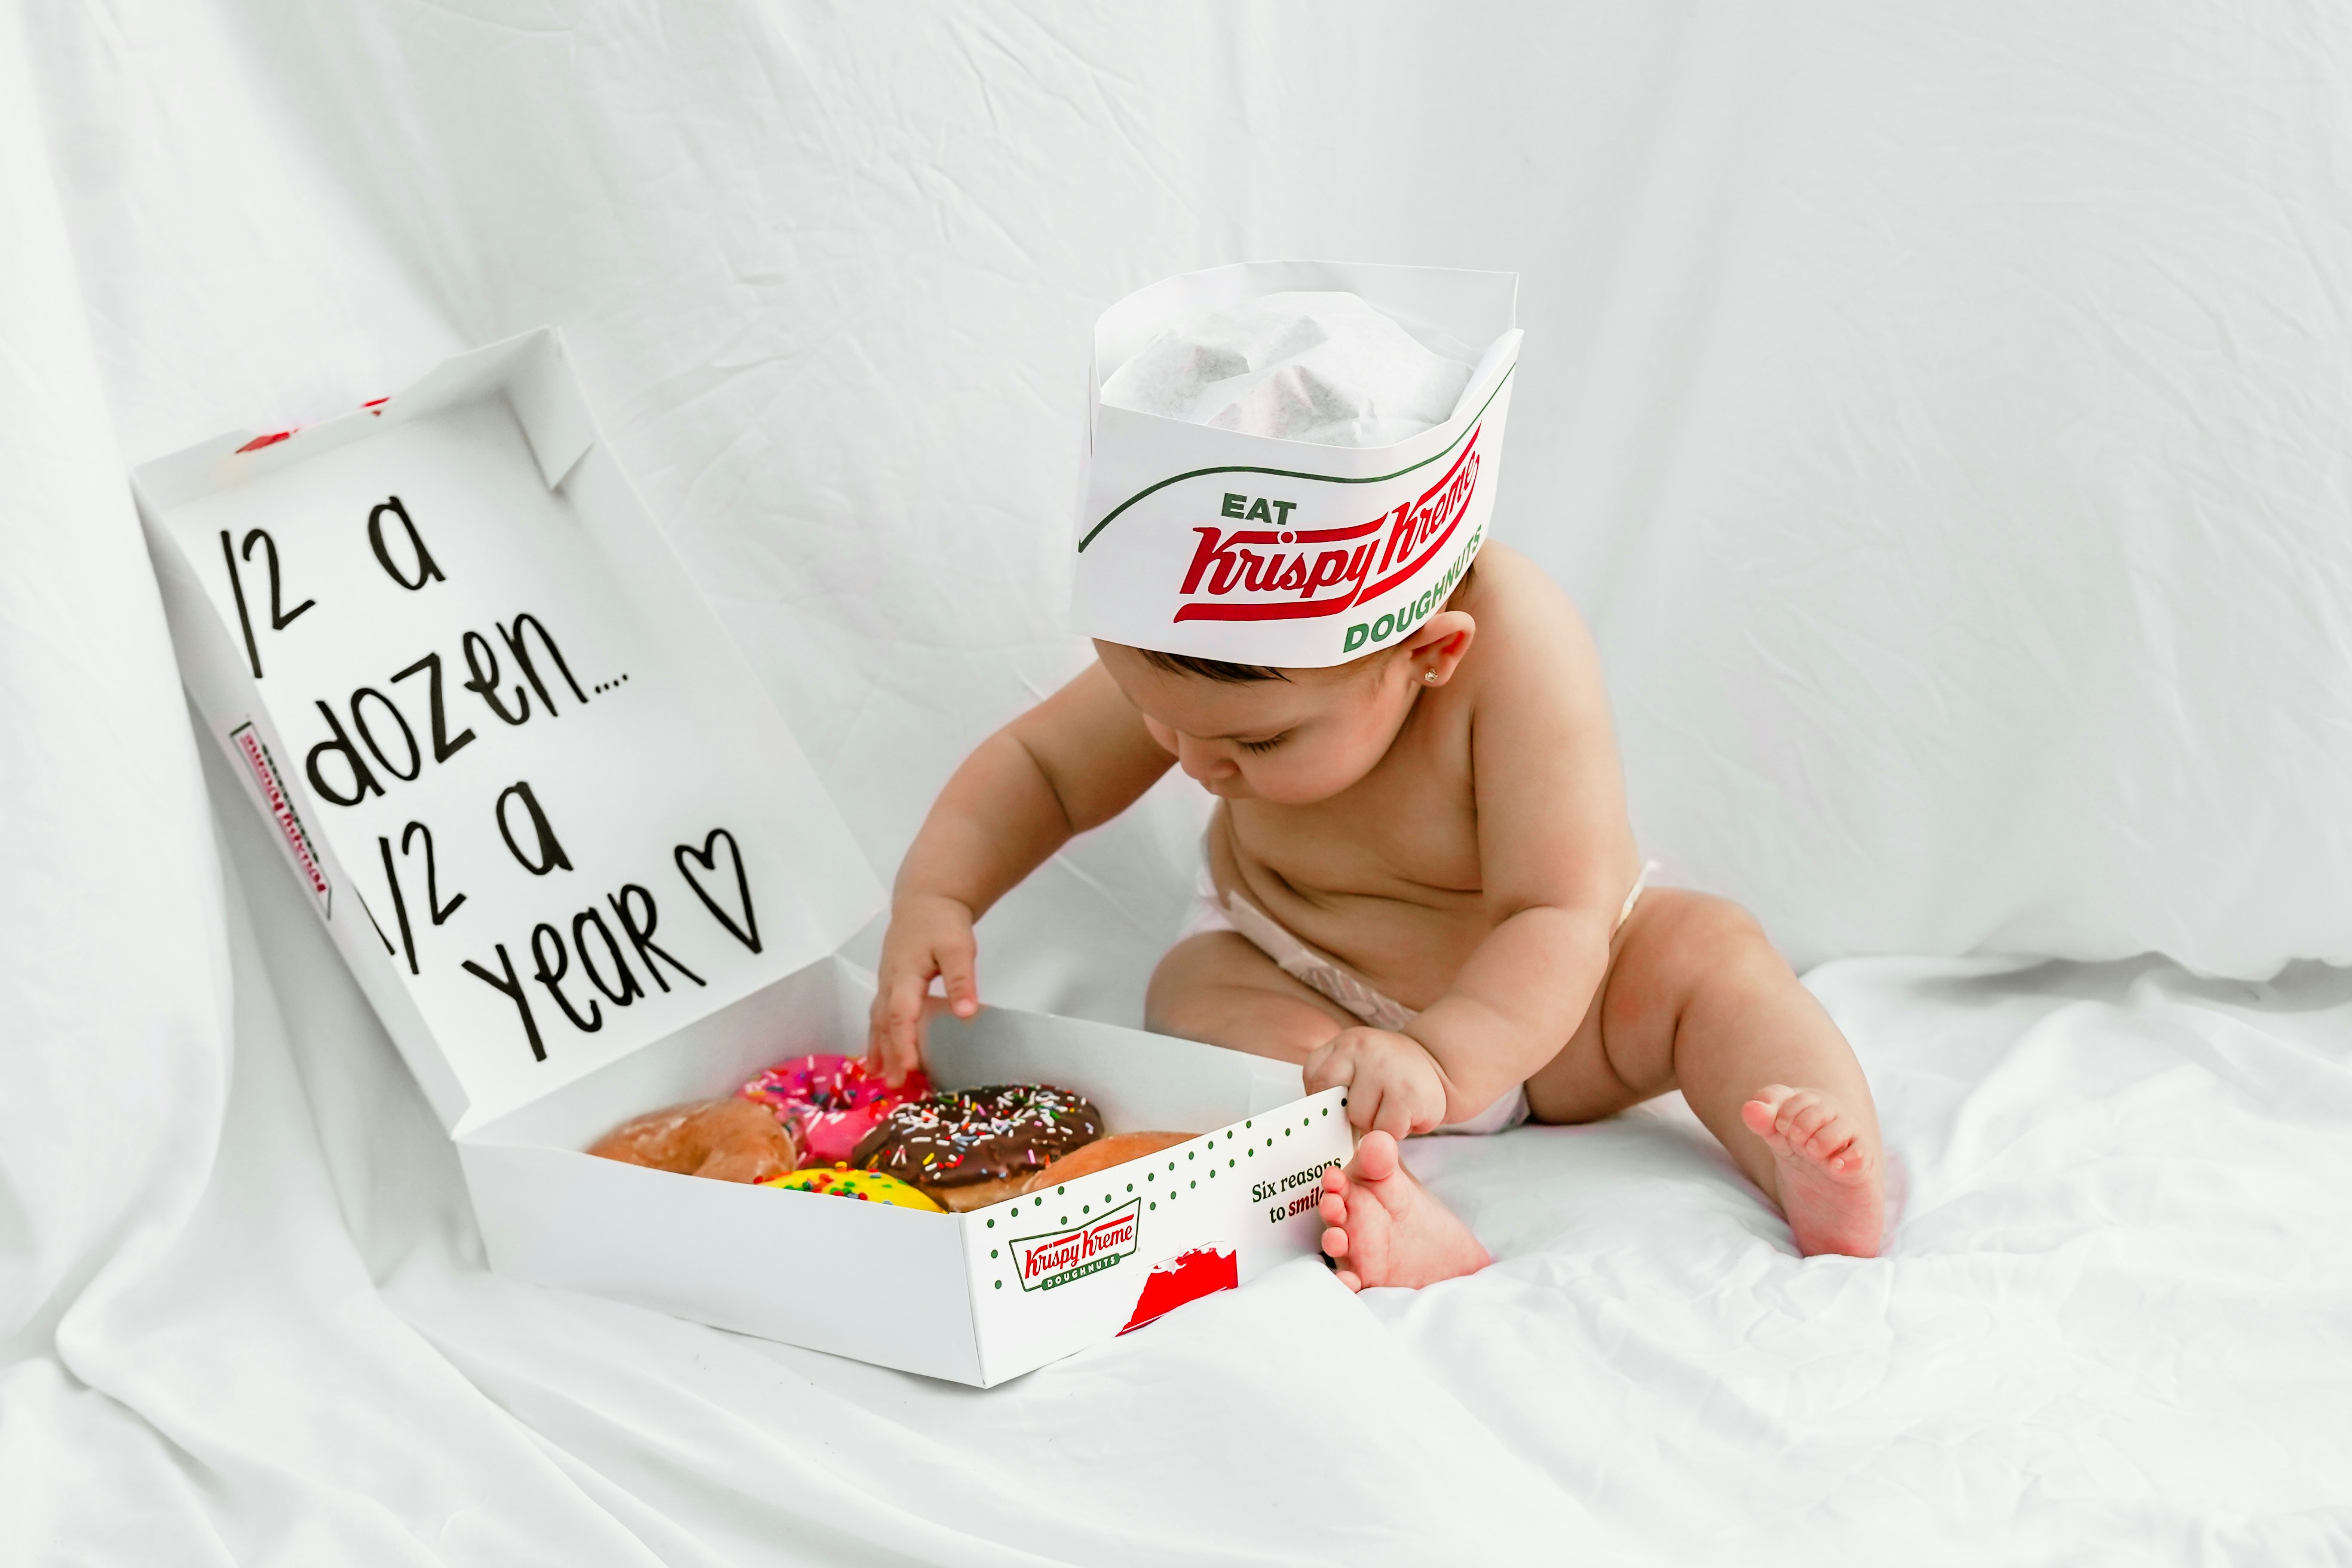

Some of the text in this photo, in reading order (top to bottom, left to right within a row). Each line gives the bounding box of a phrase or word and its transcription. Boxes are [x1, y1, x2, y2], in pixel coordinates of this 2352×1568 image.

[1174, 421, 1481, 623] Krispy Kreme
[1221, 492, 1297, 525] EAT
[368, 496, 446, 591] a
[1343, 523, 1482, 653] DOUGHNUTS
[495, 781, 574, 875] a
[1252, 1180, 1277, 1203] Six
[1269, 1186, 1324, 1223] to smil
[1025, 1214, 1134, 1279] Krispy Kreme
[1047, 1256, 1116, 1288] DOUGHNUTS
